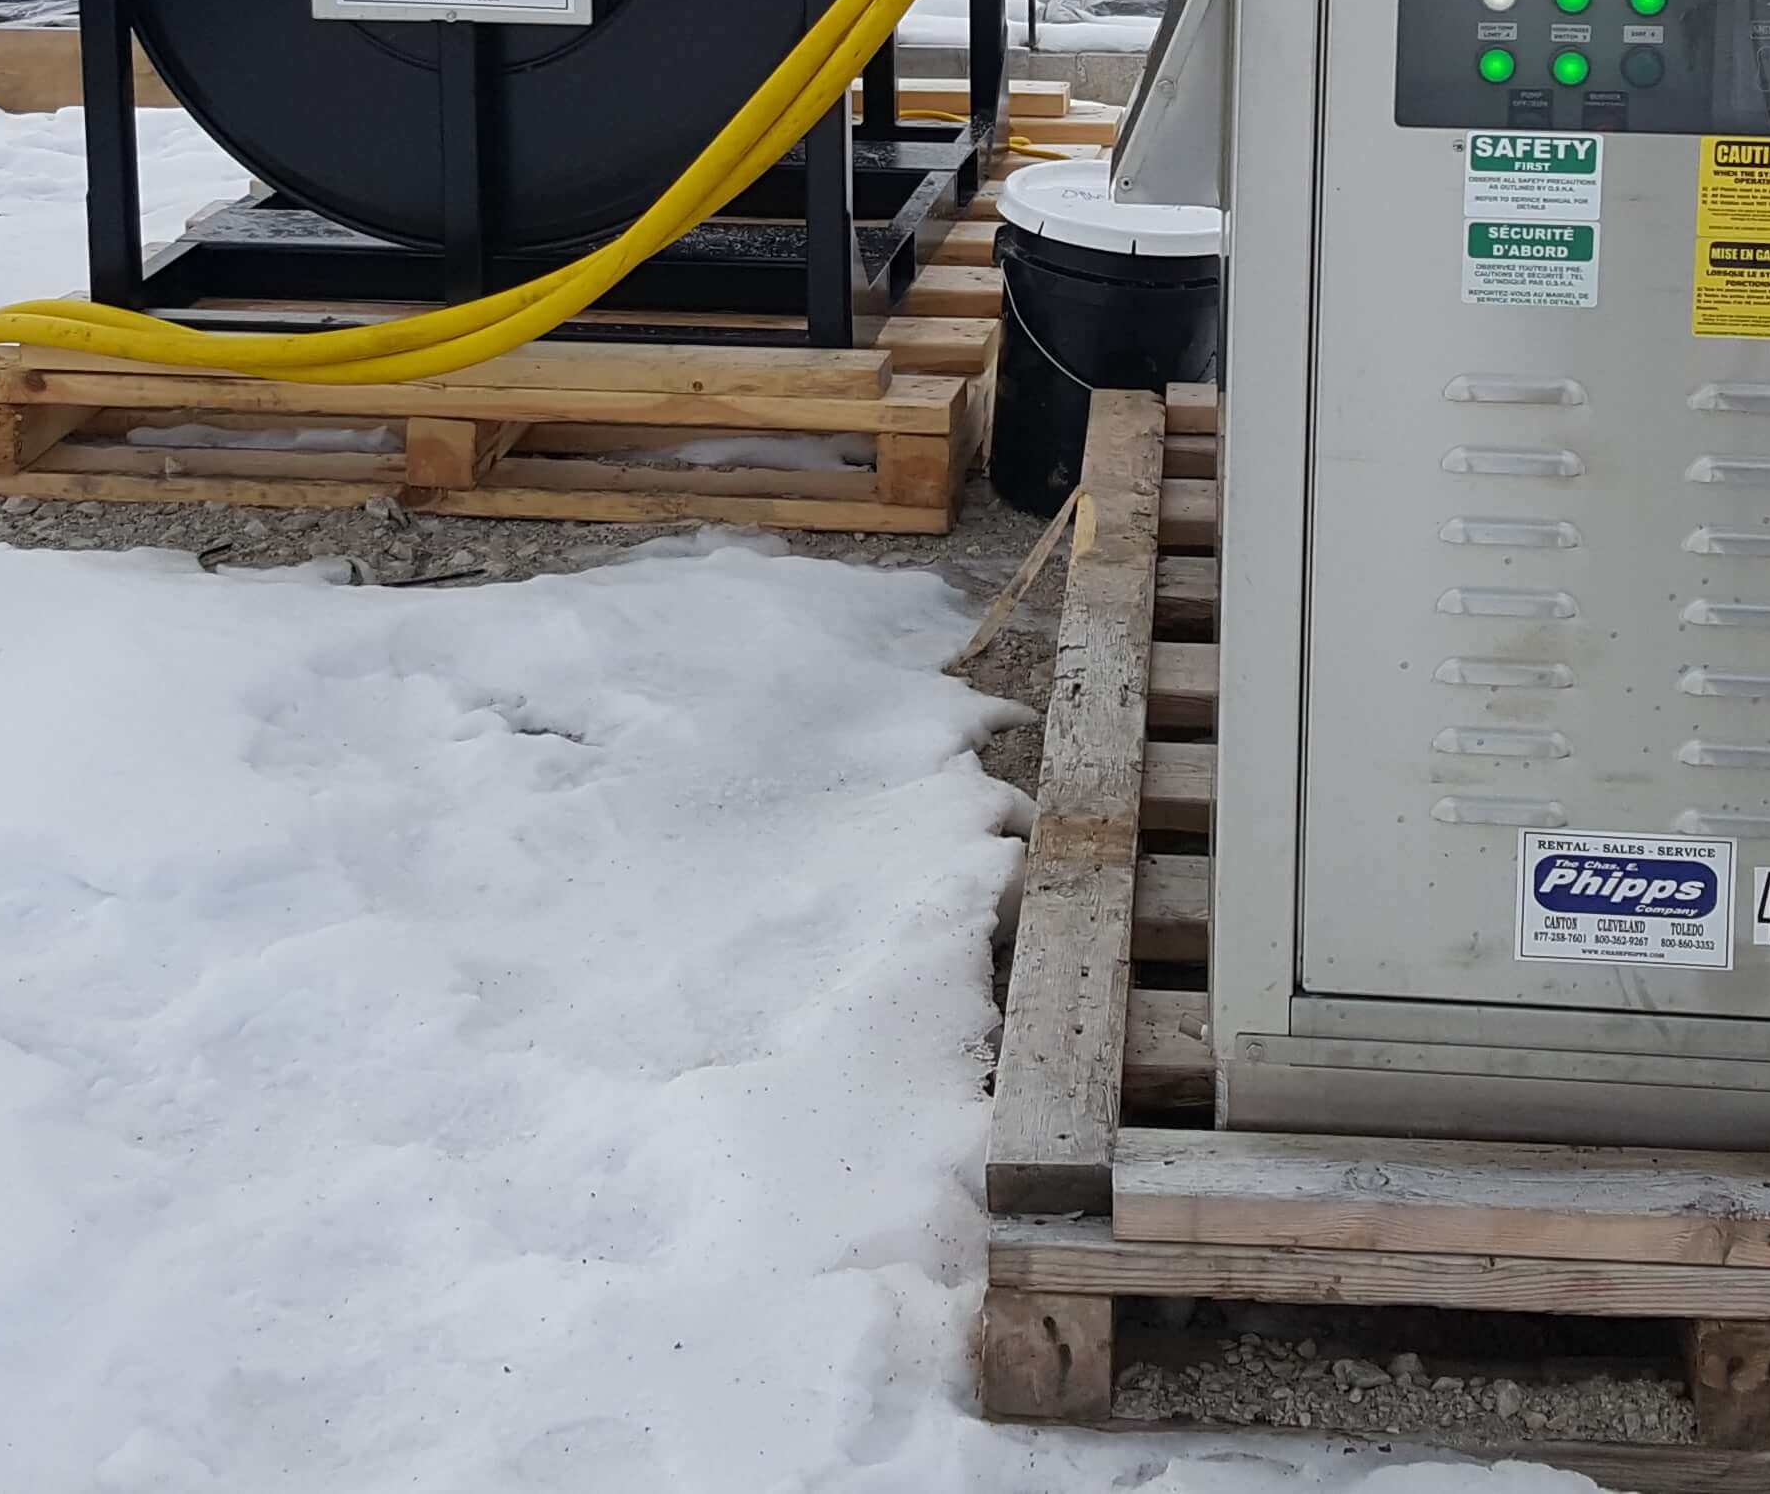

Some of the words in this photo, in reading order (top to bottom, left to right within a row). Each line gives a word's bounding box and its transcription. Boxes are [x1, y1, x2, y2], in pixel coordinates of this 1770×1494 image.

[1475, 137, 1592, 160] SAFETY
[1514, 162, 1551, 171] FIRST
[1488, 225, 1574, 241] SÉCURITÉ
[1492, 244, 1569, 258] D'ABORD
[1711, 248, 1738, 260] MISE
[1740, 249, 1754, 260] EN
[1706, 269, 1745, 277] LORSQUE
[1538, 840, 1590, 852] RENTAL
[1603, 844, 1644, 855] SALES
[1658, 846, 1716, 858] SERVICE
[1555, 859, 1579, 868] The
[1584, 860, 1620, 870] Chas.
[1539, 868, 1705, 904] Phipps
[1635, 905, 1699, 917] Company
[1544, 916, 1578, 930] CANTON
[1597, 918, 1646, 934] CLEVELAND
[1671, 922, 1704, 937] TOLEDO
[1534, 932, 1587, 944] 877-258-7601
